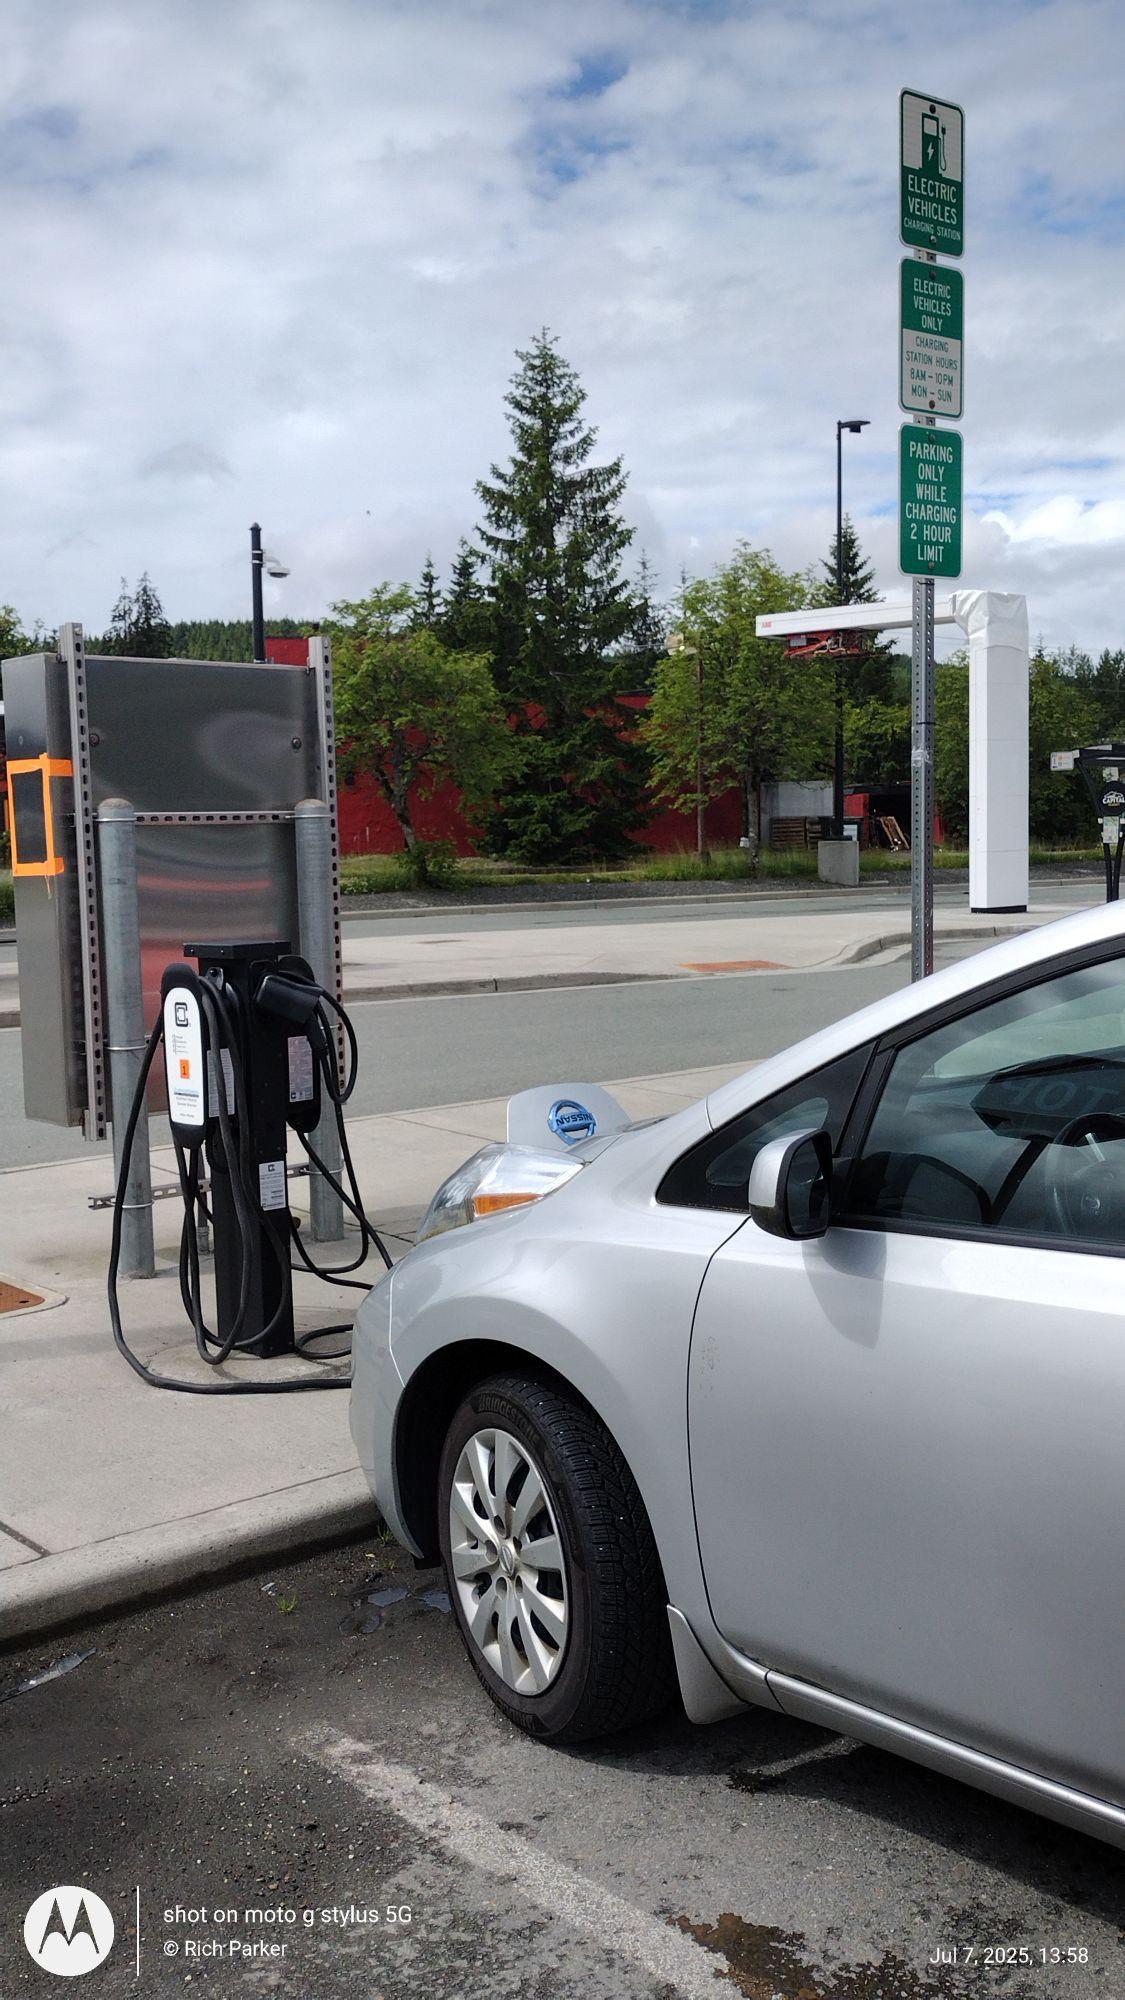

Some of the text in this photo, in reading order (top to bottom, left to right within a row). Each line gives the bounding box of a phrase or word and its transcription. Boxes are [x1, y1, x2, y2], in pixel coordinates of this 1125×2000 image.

[908, 174, 957, 203] ELECTRIC
[908, 195, 957, 225] VEHICLES
[903, 217, 961, 241] CHARGING STATION
[913, 278, 951, 299] ELECTRIC
[913, 295, 951, 316] VEHICLES
[921, 315, 943, 332] ONLY
[915, 336, 949, 353] CHARGING
[905, 351, 958, 370] STATION HOURS
[910, 368, 926, 380] 8AM
[935, 371, 954, 386] 10PM
[911, 384, 928, 398] MON
[937, 389, 952, 403] SUN
[909, 441, 953, 464] PARKING
[918, 463, 945, 482] ONLY
[915, 483, 947, 503] WHILE
[905, 502, 957, 524] CHARGING
[910, 523, 952, 543] 2 HOUR
[917, 543, 945, 563] LIMIT
[555, 1112, 594, 1127] NISSAN
